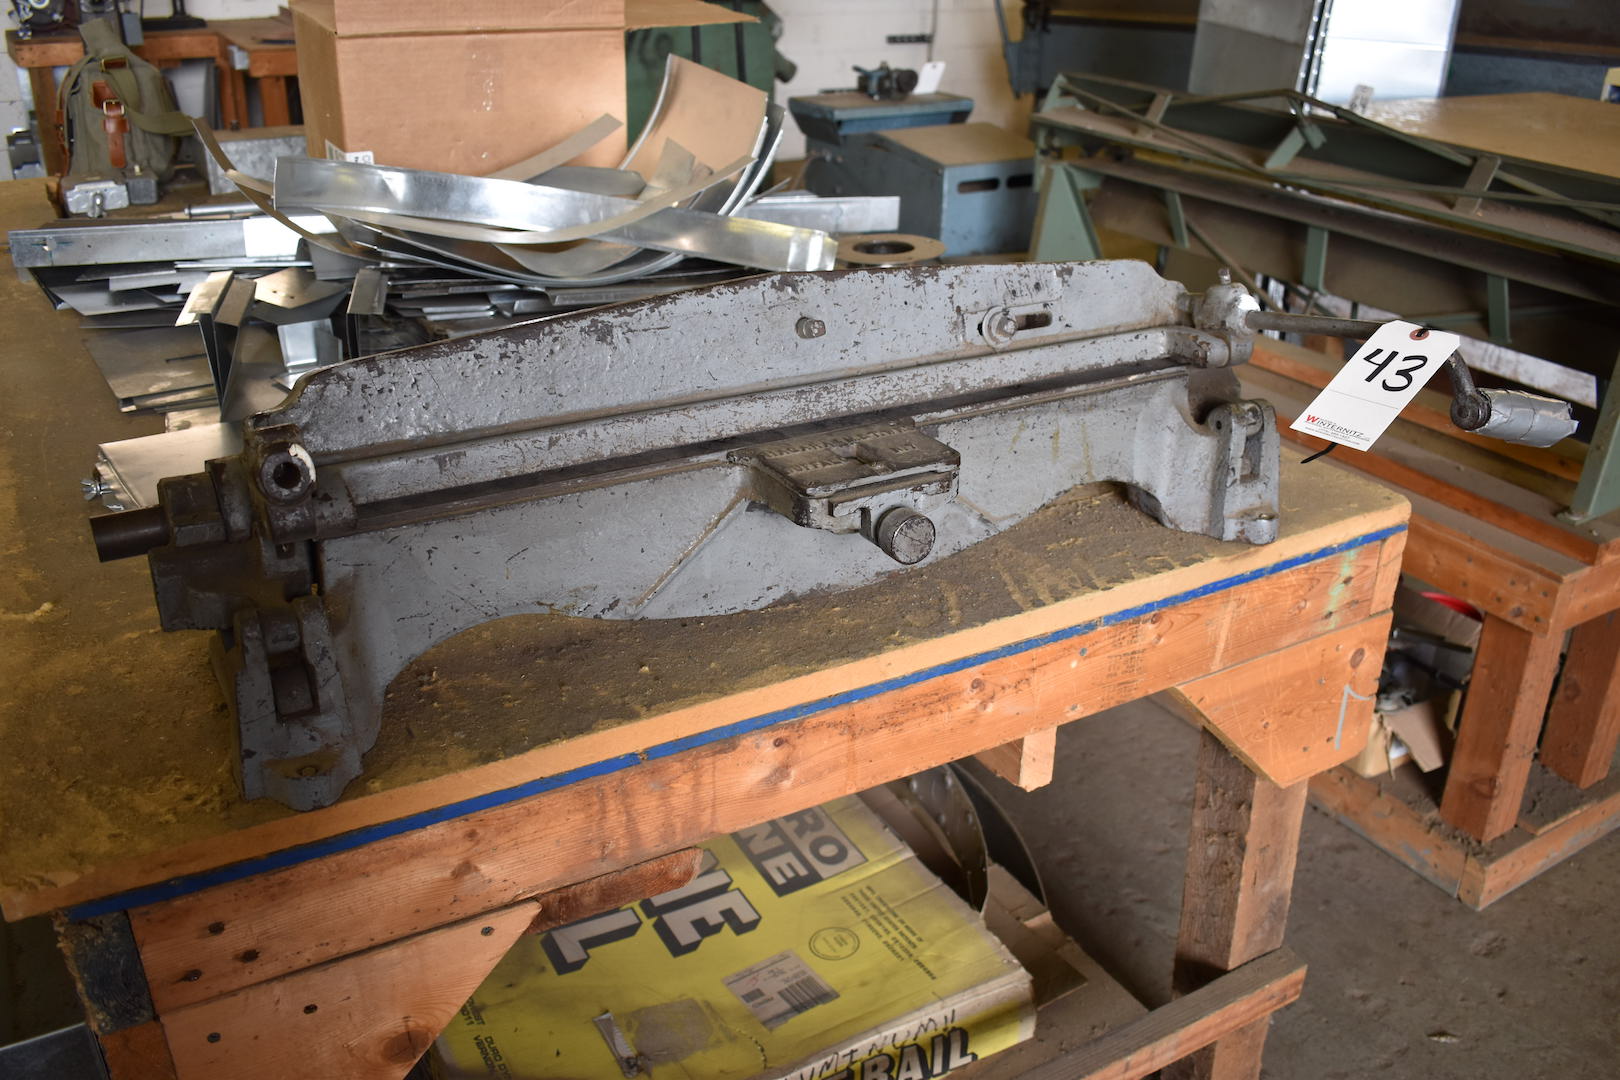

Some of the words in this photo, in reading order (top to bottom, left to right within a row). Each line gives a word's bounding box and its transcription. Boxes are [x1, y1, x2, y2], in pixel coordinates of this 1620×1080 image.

[1363, 348, 1428, 392] 43
[1306, 414, 1364, 437] WINTERNITZ
[736, 820, 809, 886] NE
[782, 807, 848, 866] RO
